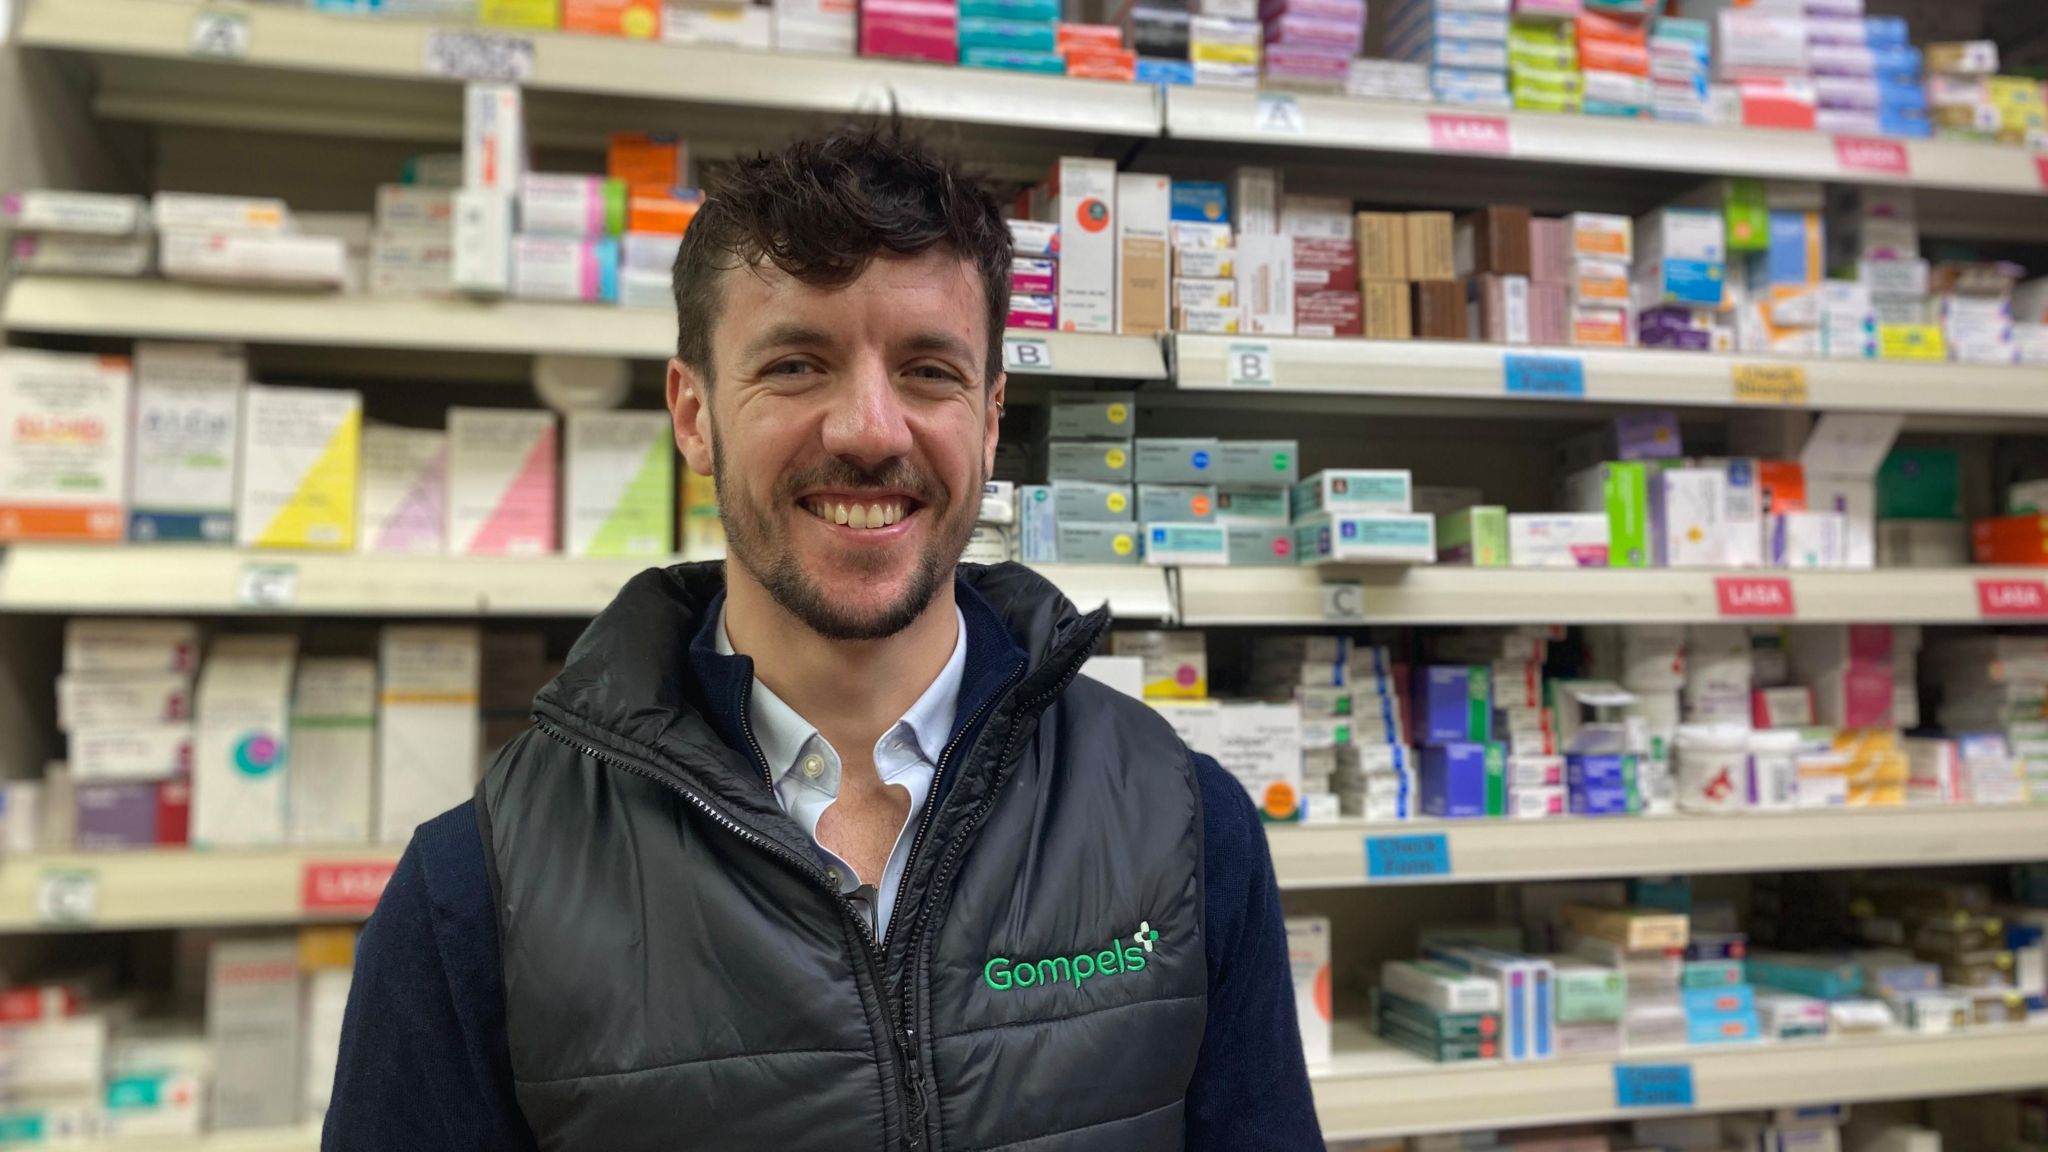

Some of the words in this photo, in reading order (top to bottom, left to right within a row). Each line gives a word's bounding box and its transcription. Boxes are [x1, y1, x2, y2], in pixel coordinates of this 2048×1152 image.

[1269, 100, 1291, 128] A
[1440, 120, 1499, 141] LASA
[1016, 344, 1041, 365] B
[1239, 354, 1263, 379] B
[1332, 585, 1356, 616] C
[1728, 584, 1785, 607] LASA
[1987, 585, 2043, 608] LASA
[984, 938, 1147, 991] Gompels
